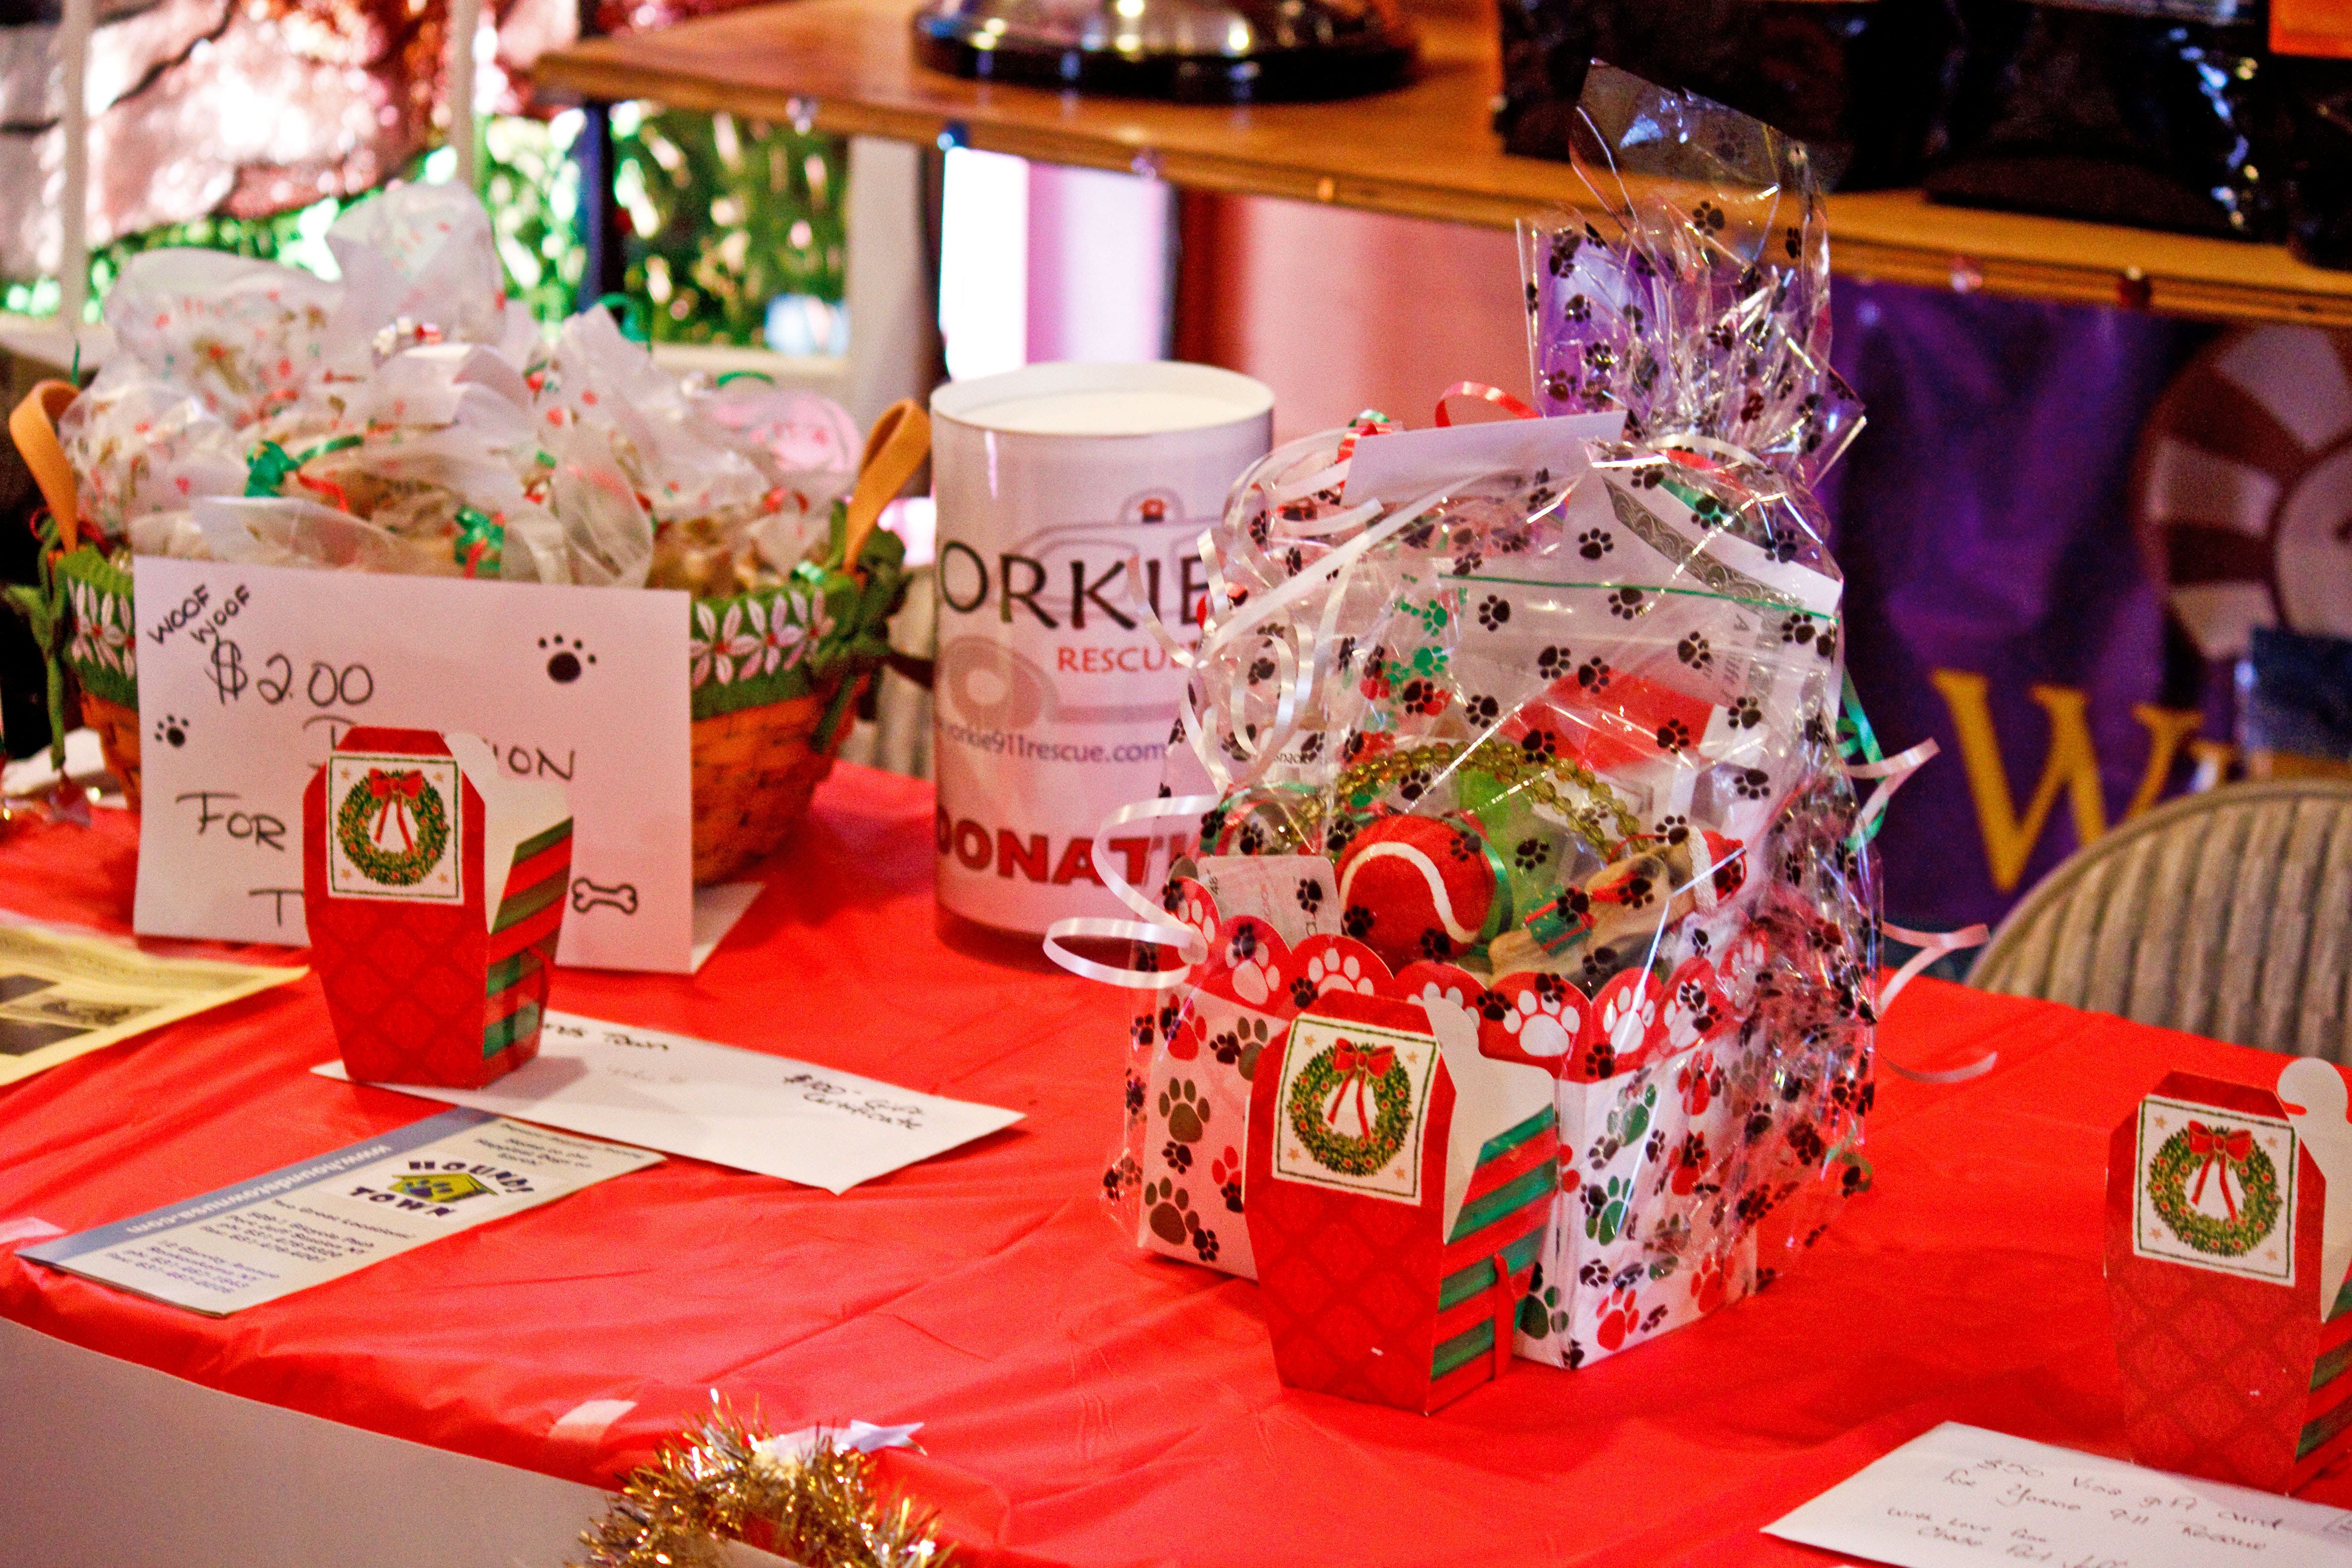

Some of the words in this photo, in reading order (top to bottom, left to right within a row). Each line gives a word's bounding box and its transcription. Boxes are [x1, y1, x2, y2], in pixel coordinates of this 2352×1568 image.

[147, 583, 209, 644] WOOF
[189, 584, 250, 644] WOOF
[205, 636, 374, 707] $2.00
[176, 791, 286, 851] FOR
[350, 1186, 455, 1216] TOWN
[409, 1161, 532, 1192] HOUNDS
